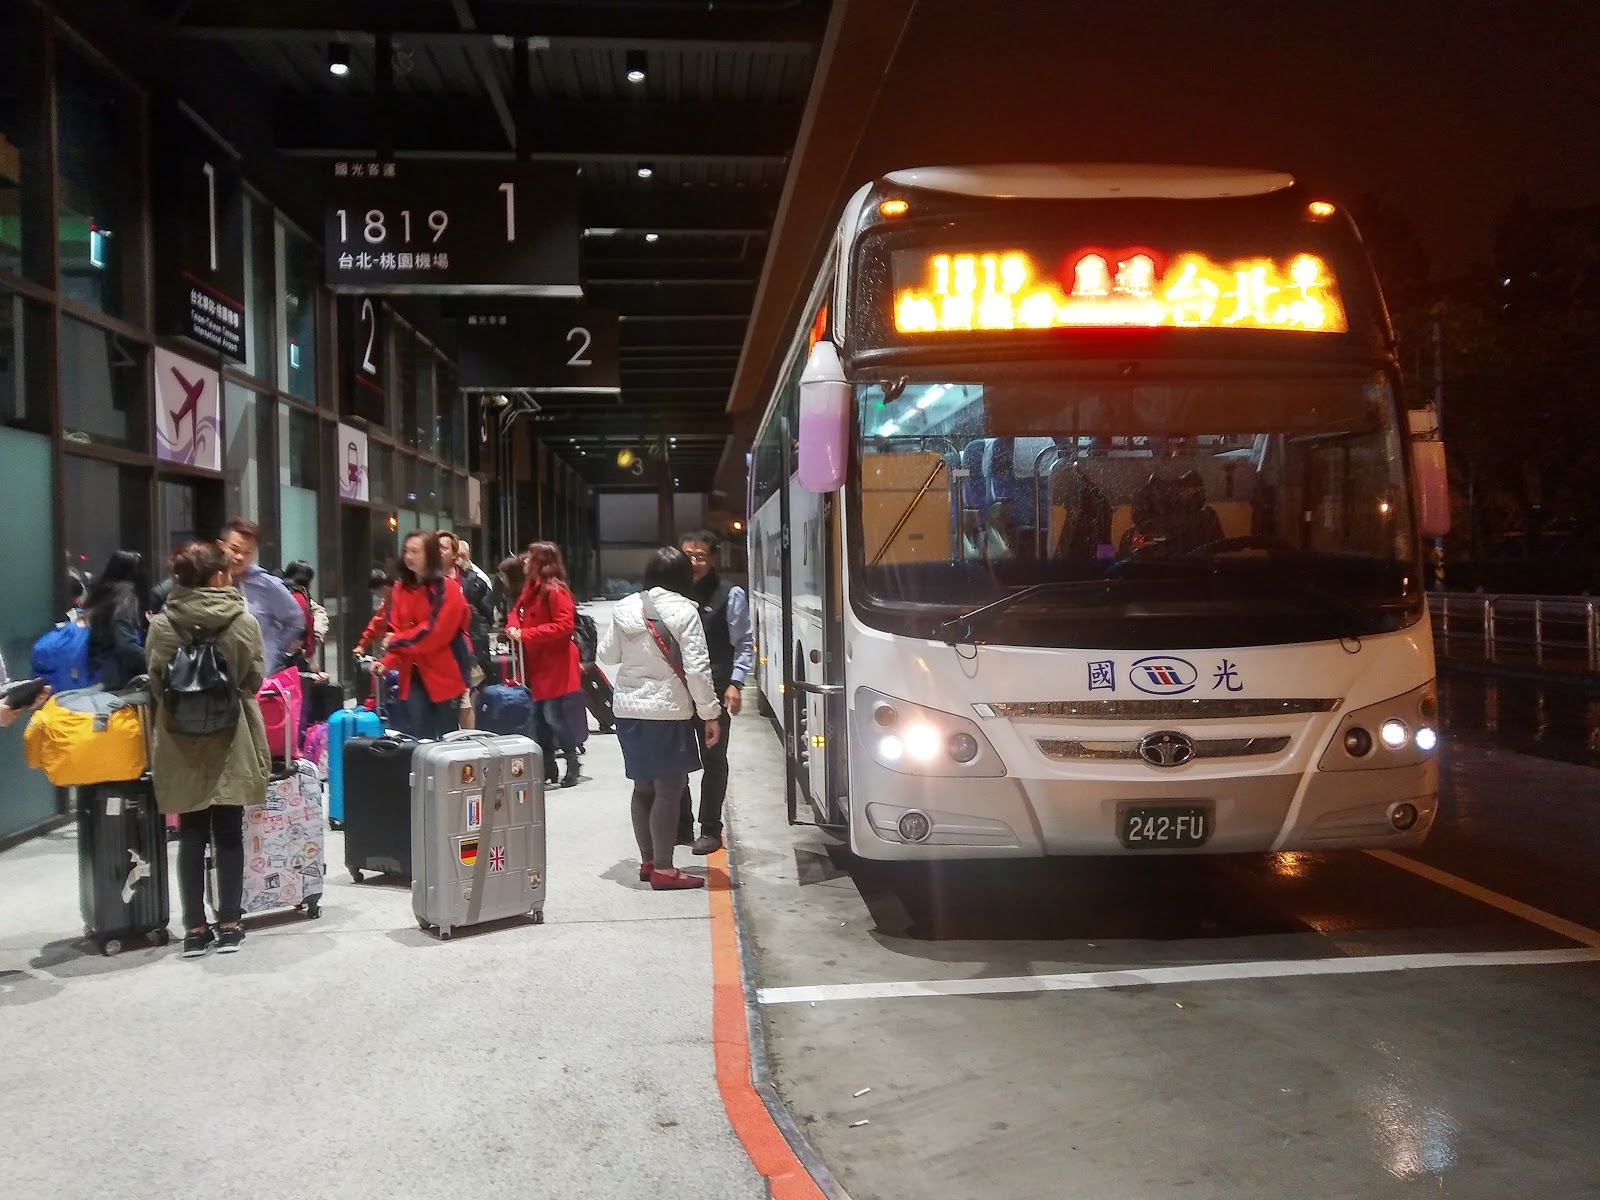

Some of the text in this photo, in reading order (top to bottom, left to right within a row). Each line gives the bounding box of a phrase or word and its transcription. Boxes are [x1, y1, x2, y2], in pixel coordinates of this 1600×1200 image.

[203, 162, 217, 270] 1
[336, 209, 449, 244] 1819
[498, 182, 515, 242] 1
[338, 252, 449, 270] 台北-桃園機場
[362, 298, 376, 375] 2
[566, 327, 593, 366] 2
[631, 457, 644, 476] 3
[1087, 658, 1244, 692] 國 光
[1129, 816, 1204, 841] 242-FU
